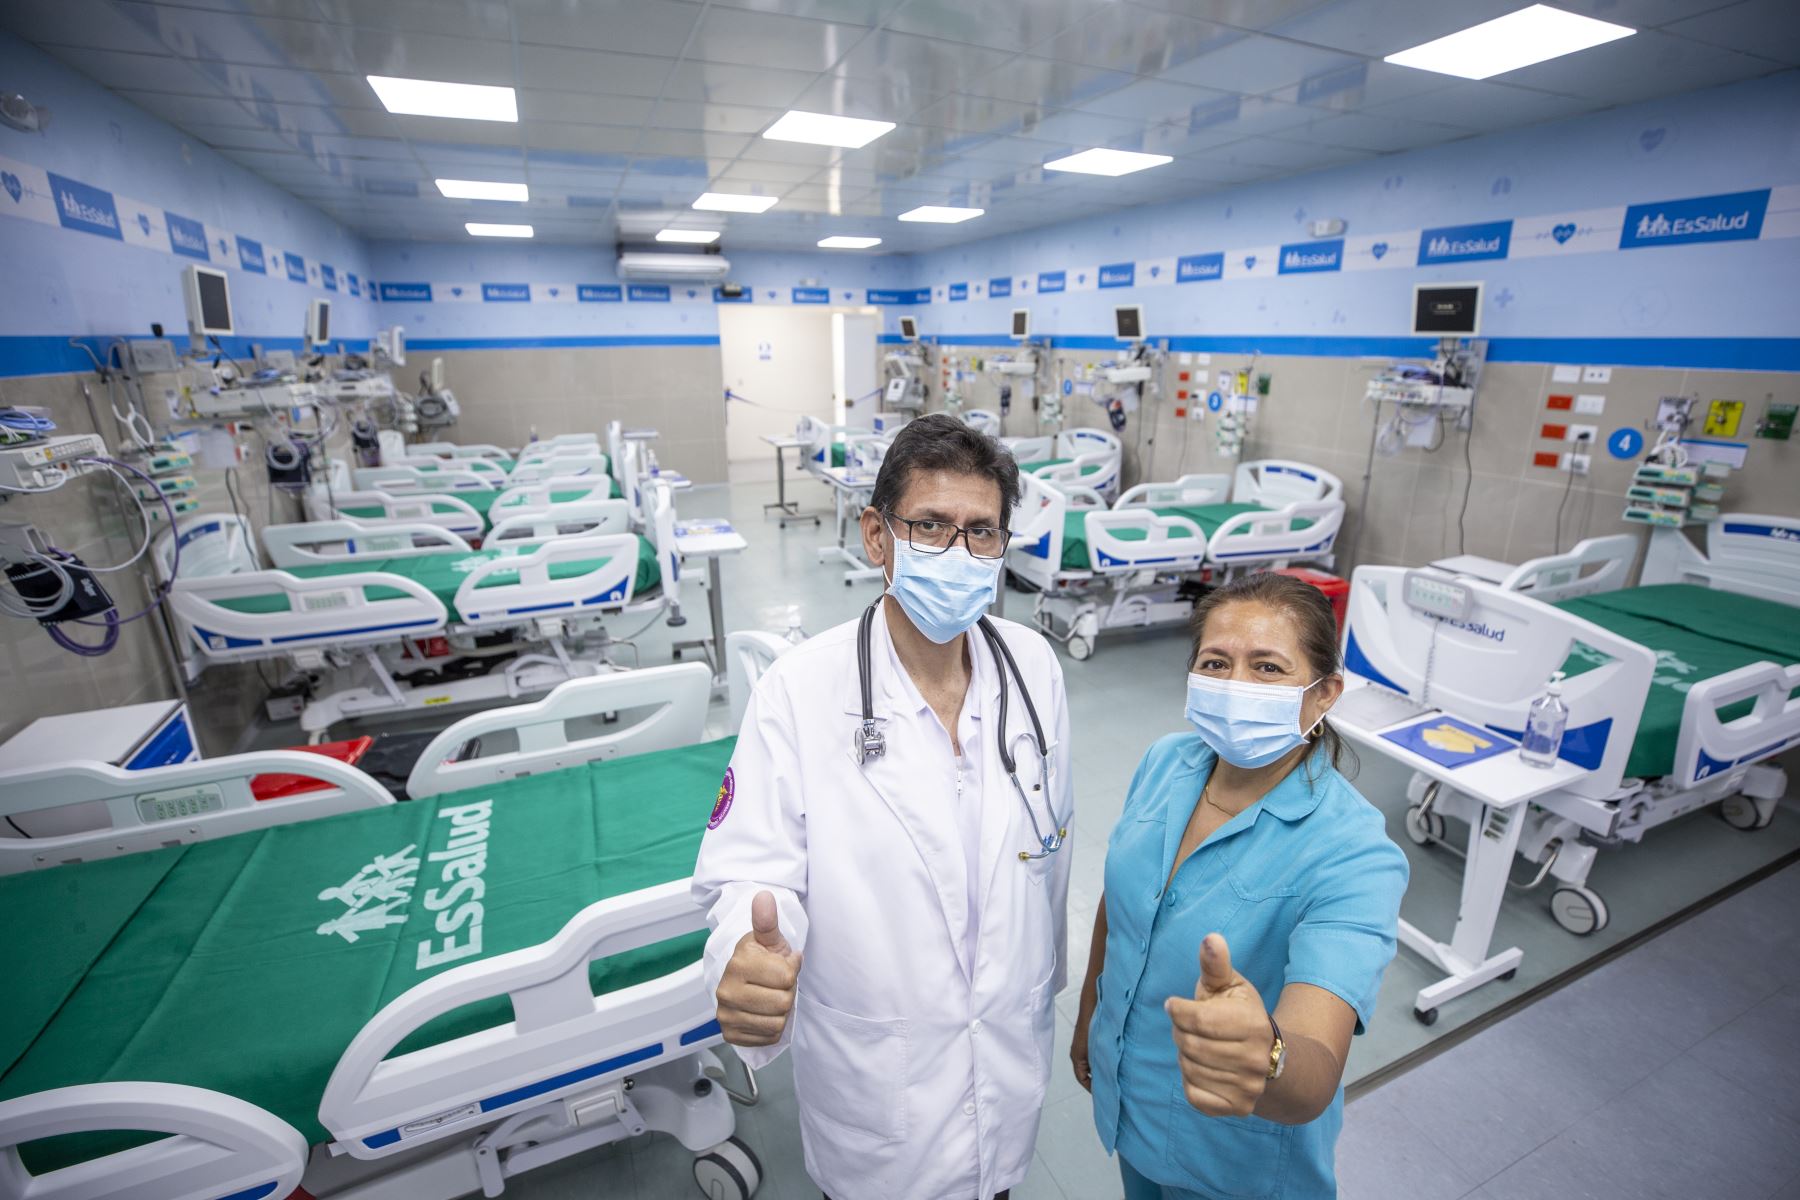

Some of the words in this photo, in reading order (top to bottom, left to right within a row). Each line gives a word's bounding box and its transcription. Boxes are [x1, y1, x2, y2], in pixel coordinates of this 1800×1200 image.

[1672, 211, 1749, 235] EsSalud
[1452, 236, 1500, 254] EsSalud
[1618, 433, 1632, 452] 4
[415, 799, 494, 971] EsSalud
